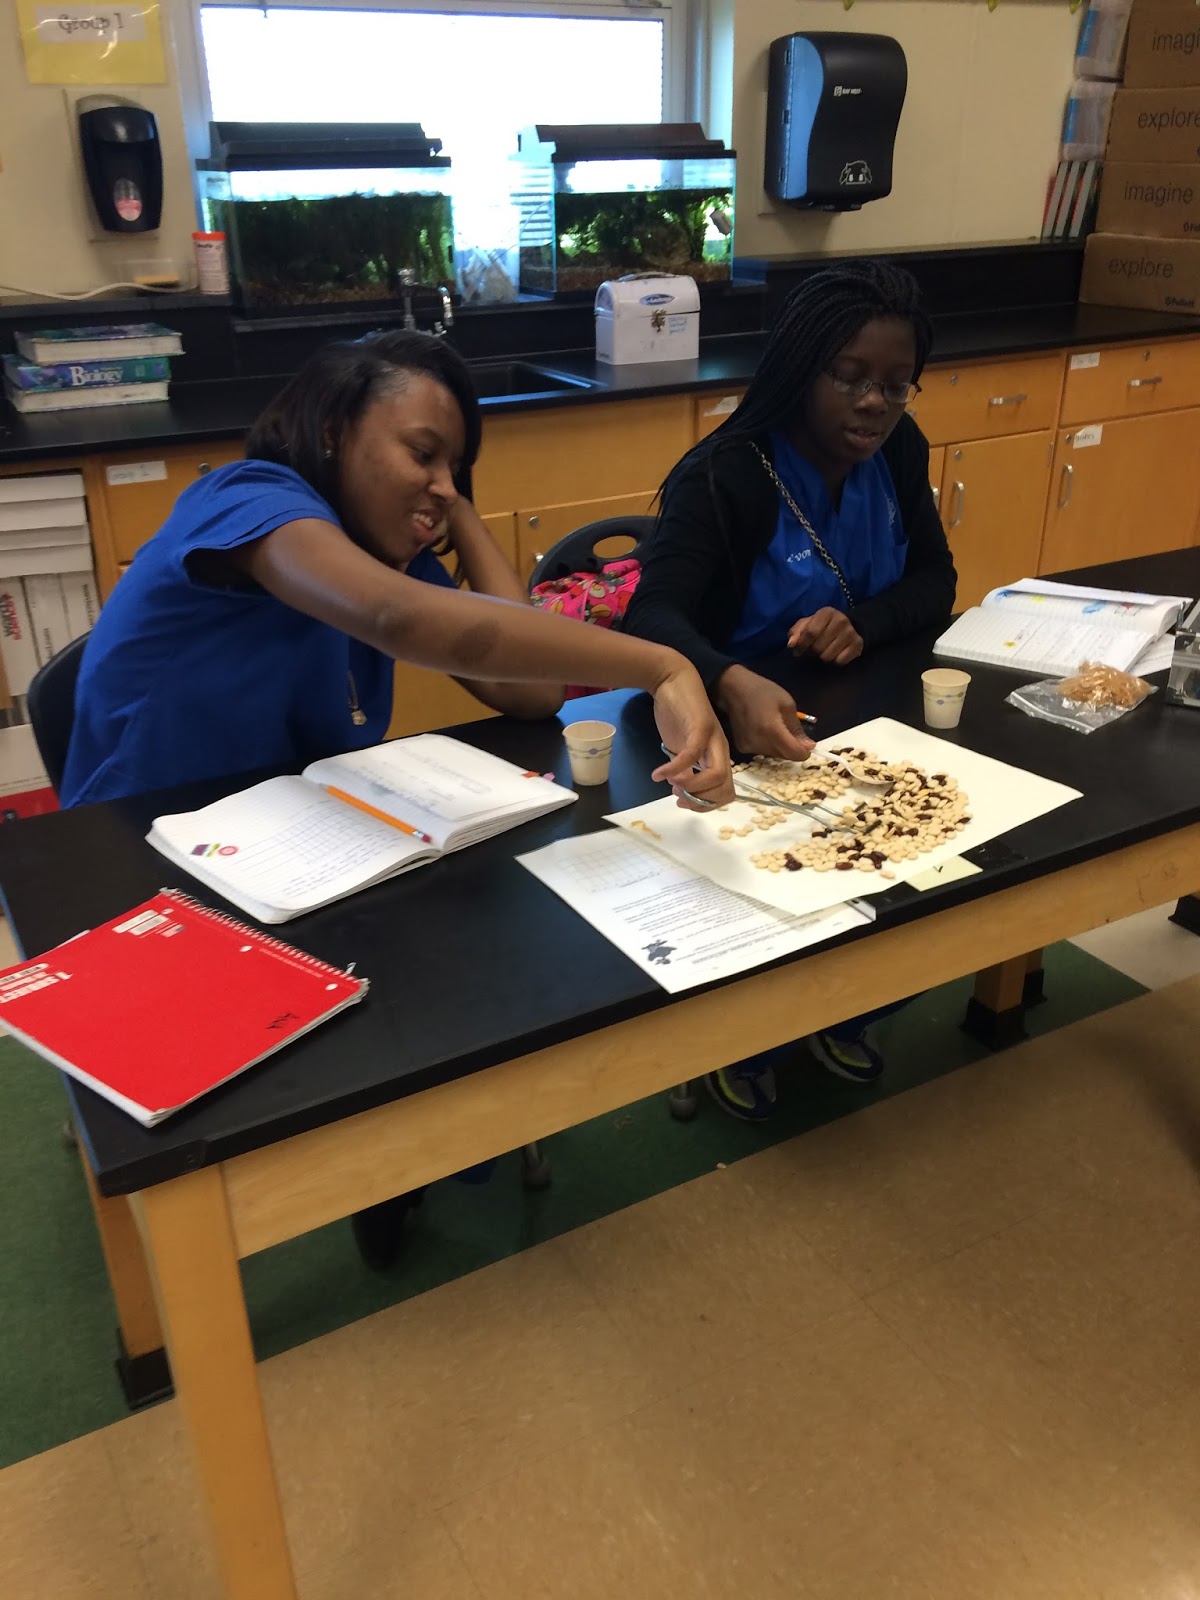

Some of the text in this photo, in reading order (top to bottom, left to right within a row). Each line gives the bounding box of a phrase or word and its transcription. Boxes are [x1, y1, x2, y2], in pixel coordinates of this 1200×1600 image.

[58, 12, 124, 34] Group 1
[1124, 181, 1194, 207] imagine
[1108, 257, 1173, 279] explore
[69, 365, 124, 387] Biology
